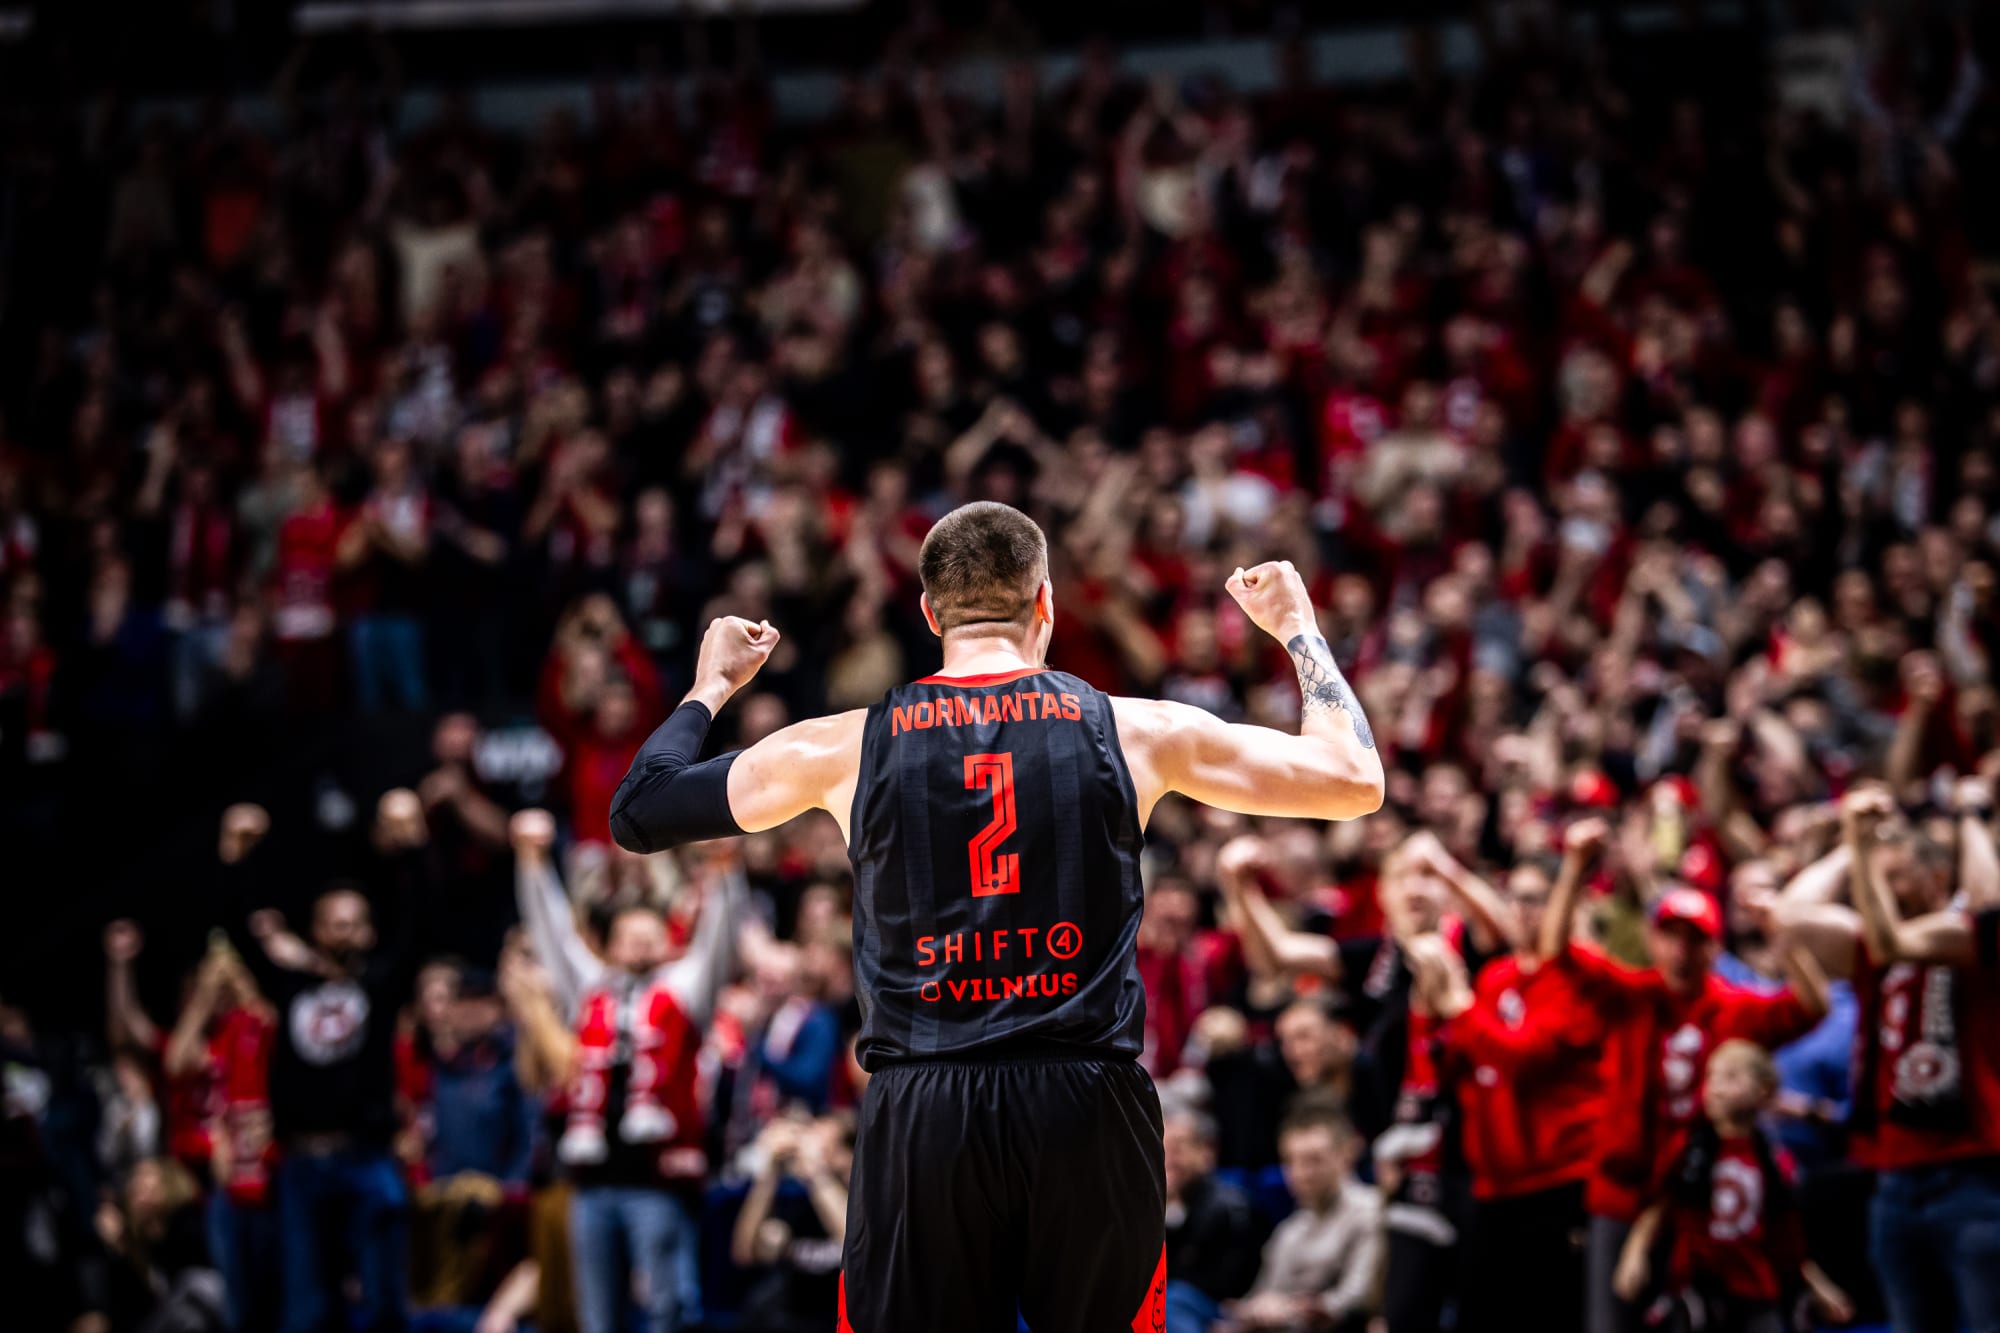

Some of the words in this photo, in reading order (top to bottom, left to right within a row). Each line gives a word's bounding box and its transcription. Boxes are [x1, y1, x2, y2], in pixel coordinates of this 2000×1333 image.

[891, 692, 1081, 736] NORMANTAS
[963, 751, 1021, 897] 2
[947, 972, 1078, 1002] VILNIUS
